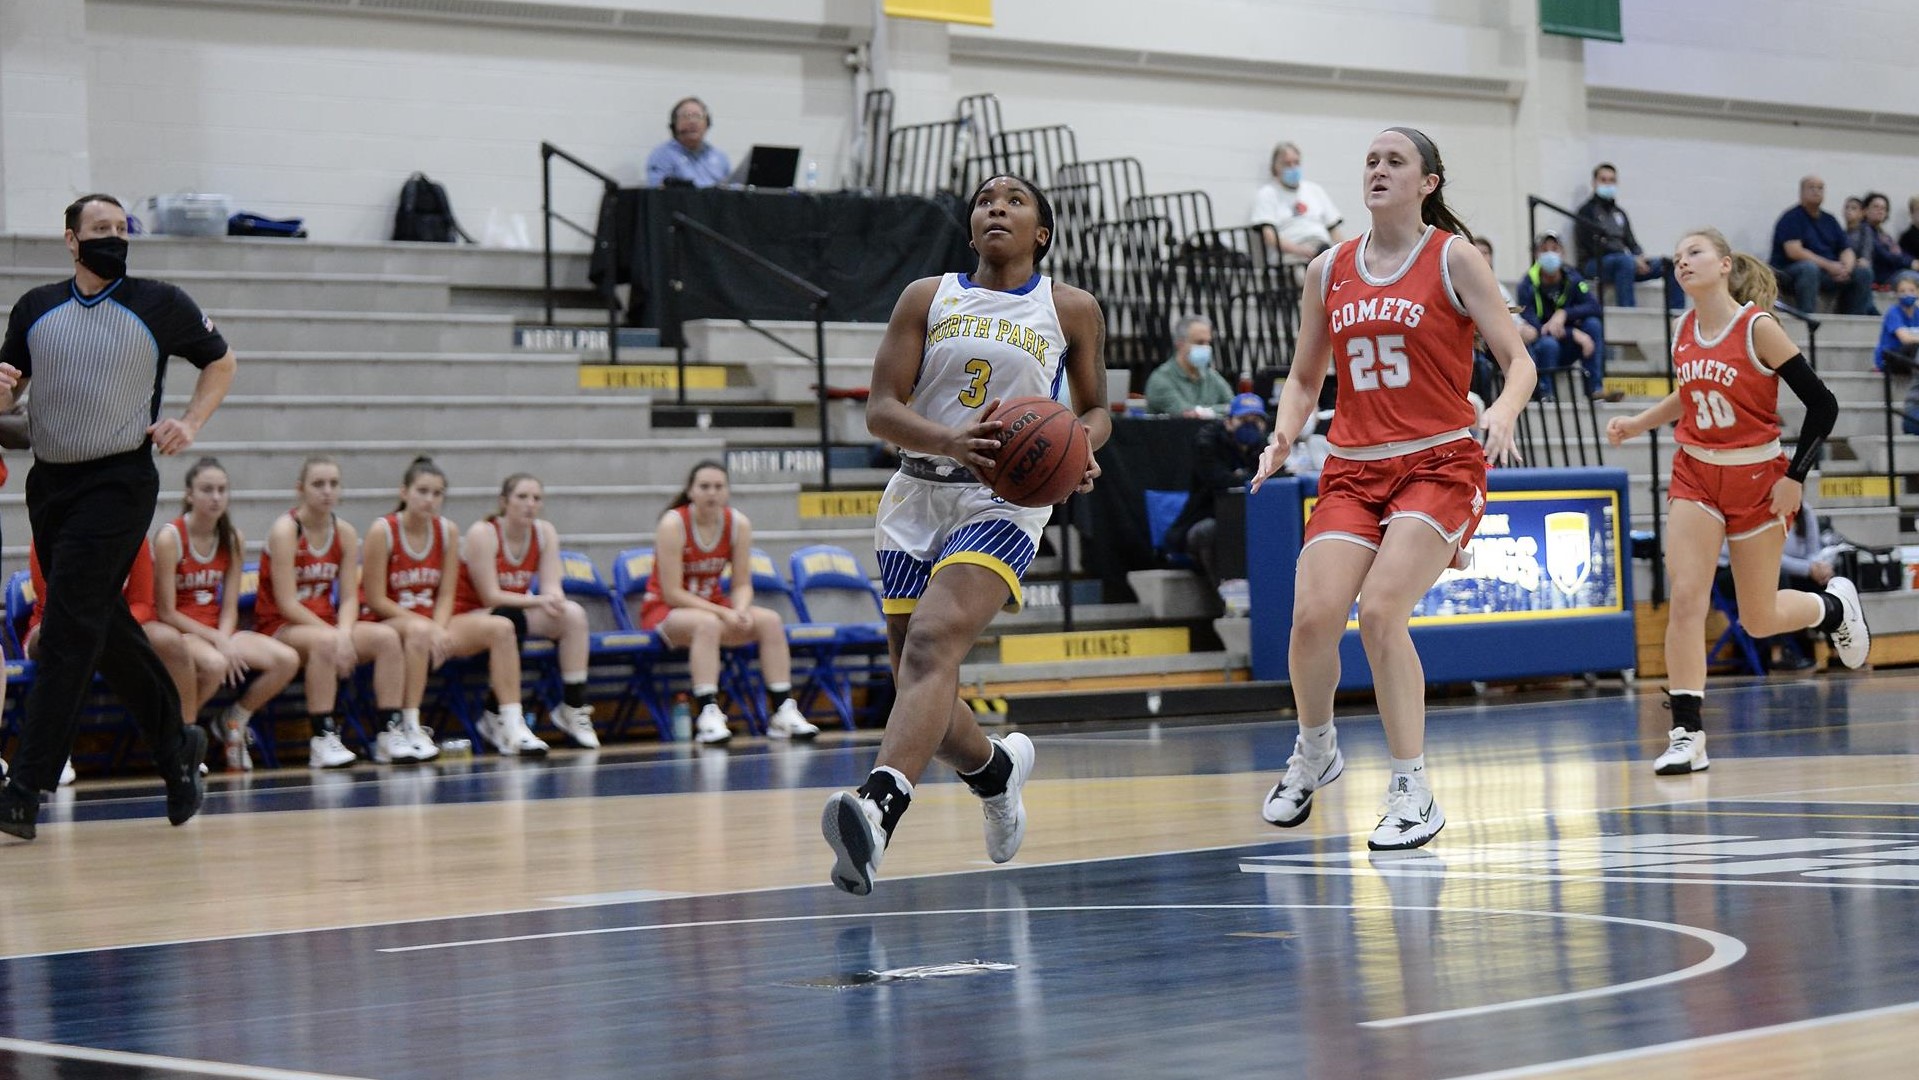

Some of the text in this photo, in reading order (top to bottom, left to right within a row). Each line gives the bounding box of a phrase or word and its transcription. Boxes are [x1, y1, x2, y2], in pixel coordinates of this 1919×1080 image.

[1332, 297, 1425, 333] COMETS
[522, 329, 573, 348] NORTH
[928, 313, 1050, 367] NORTH PARK
[606, 367, 669, 387] VIKINGS
[1346, 334, 1411, 392] 25
[1677, 359, 1738, 387] COMETS
[958, 358, 992, 408] 3
[1690, 389, 1737, 430] 30
[728, 450, 780, 472] NORTH
[1008, 436, 1051, 486] NCAA
[1065, 634, 1131, 657] VIKINGS
